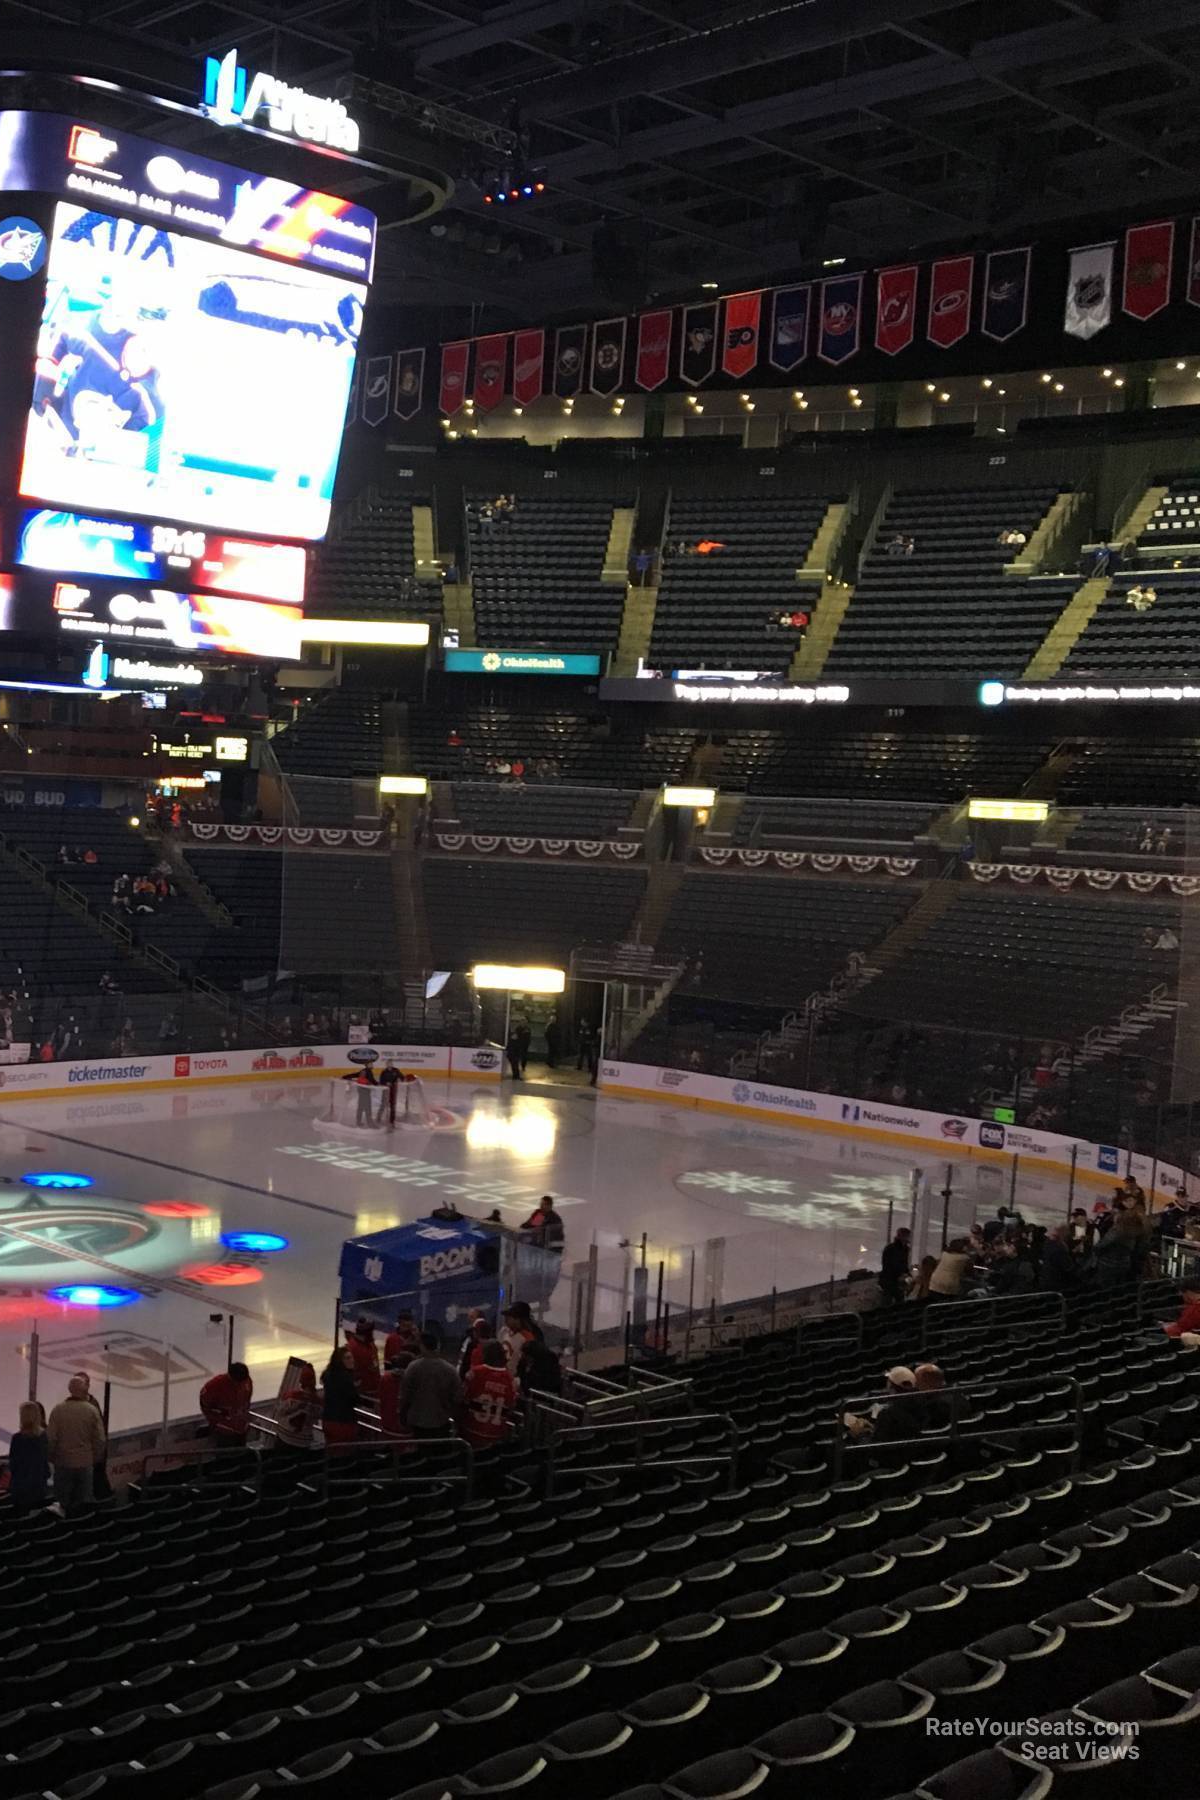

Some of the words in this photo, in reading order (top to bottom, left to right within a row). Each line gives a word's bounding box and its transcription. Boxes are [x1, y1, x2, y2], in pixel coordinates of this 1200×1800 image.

[503, 657, 565, 669] OhioHealth
[34, 791, 65, 805] BUD
[193, 1059, 228, 1070] TOYOTA
[7, 1073, 48, 1083] SECURITY
[68, 1064, 147, 1083] ticketmaster
[602, 1067, 620, 1077] CBJ
[753, 1090, 817, 1111] OhioHealth
[863, 1109, 920, 1129] Nationwide
[420, 1244, 476, 1277] BOOM
